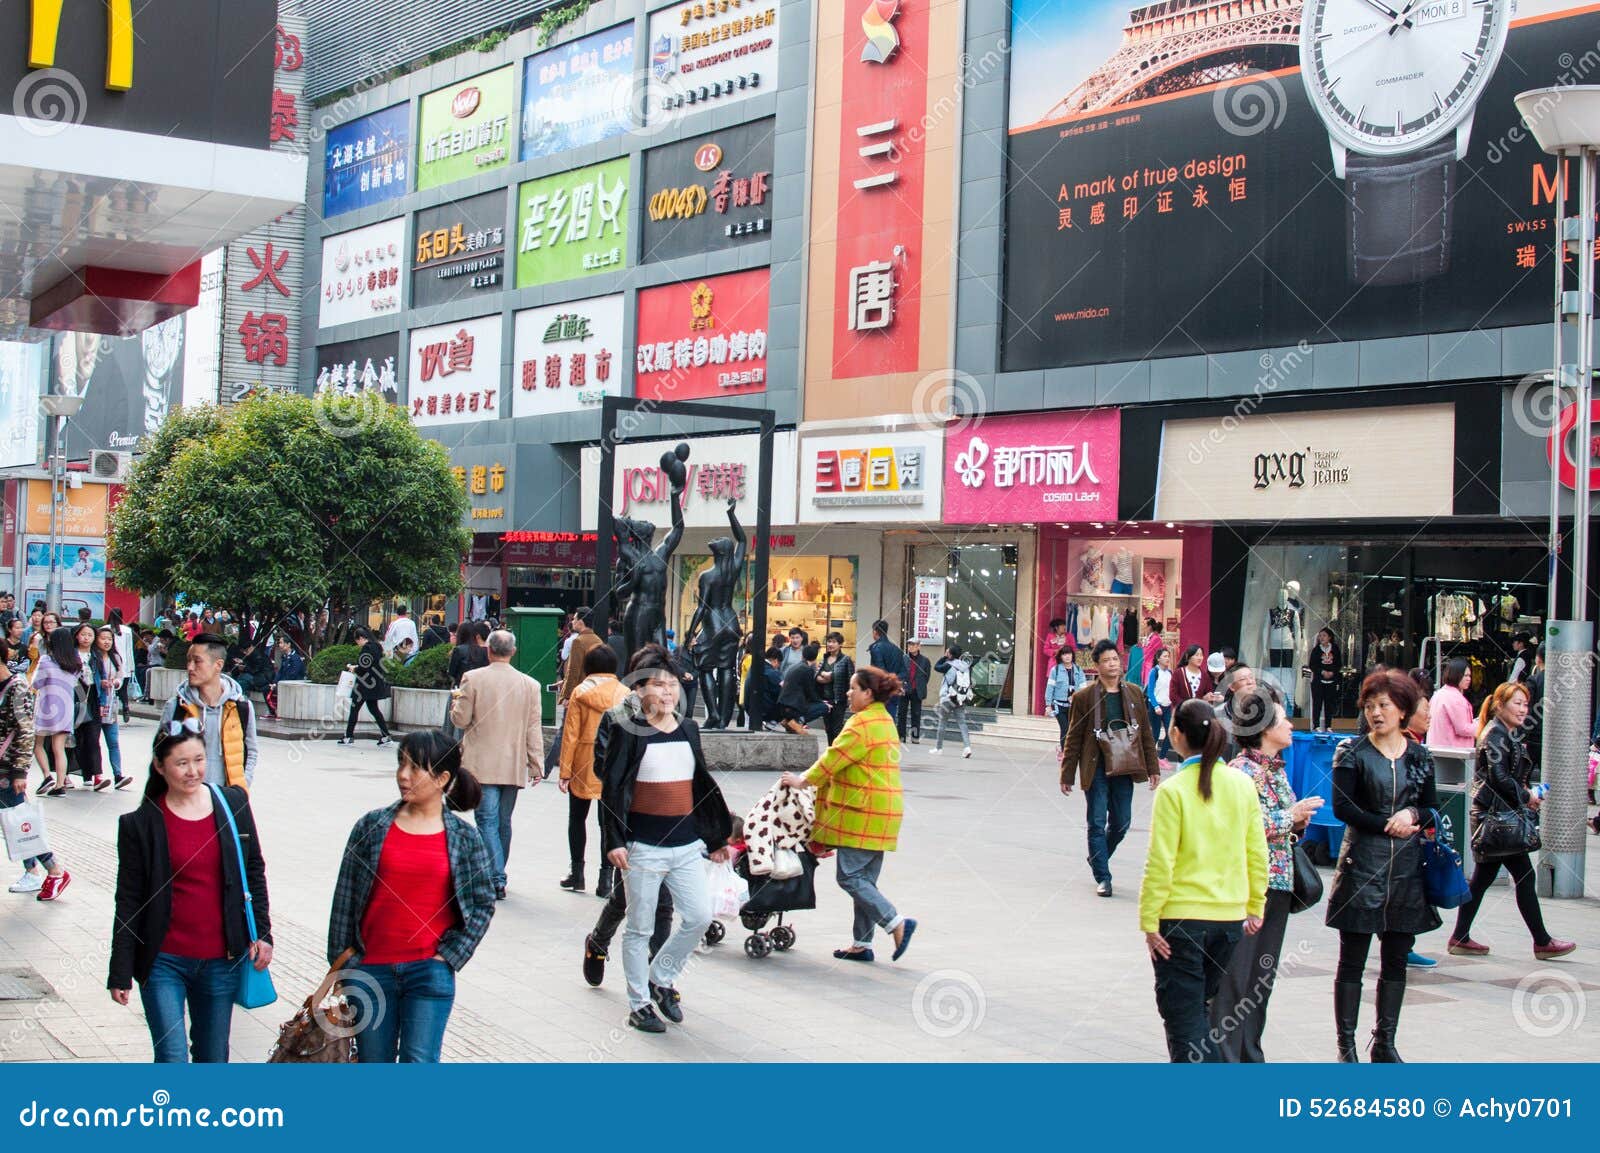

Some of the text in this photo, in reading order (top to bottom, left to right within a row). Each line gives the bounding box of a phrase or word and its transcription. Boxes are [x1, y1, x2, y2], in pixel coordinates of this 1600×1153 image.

[1421, 2, 1460, 20] MON 8
[1375, 72, 1424, 87] COMMANDER
[1058, 154, 1246, 201] A mark of true design
[1057, 177, 1247, 231] 灵感印证永恒
[1507, 219, 1546, 234] SWISS
[463, 261, 478, 273] FOOD
[479, 257, 497, 269] PLAZA
[1054, 306, 1110, 322] www.mido.cn
[521, 349, 613, 392] 眼镜超市
[109, 431, 139, 448] Premier
[816, 453, 921, 487] 三唐百货
[993, 442, 1100, 488] 都市丽人
